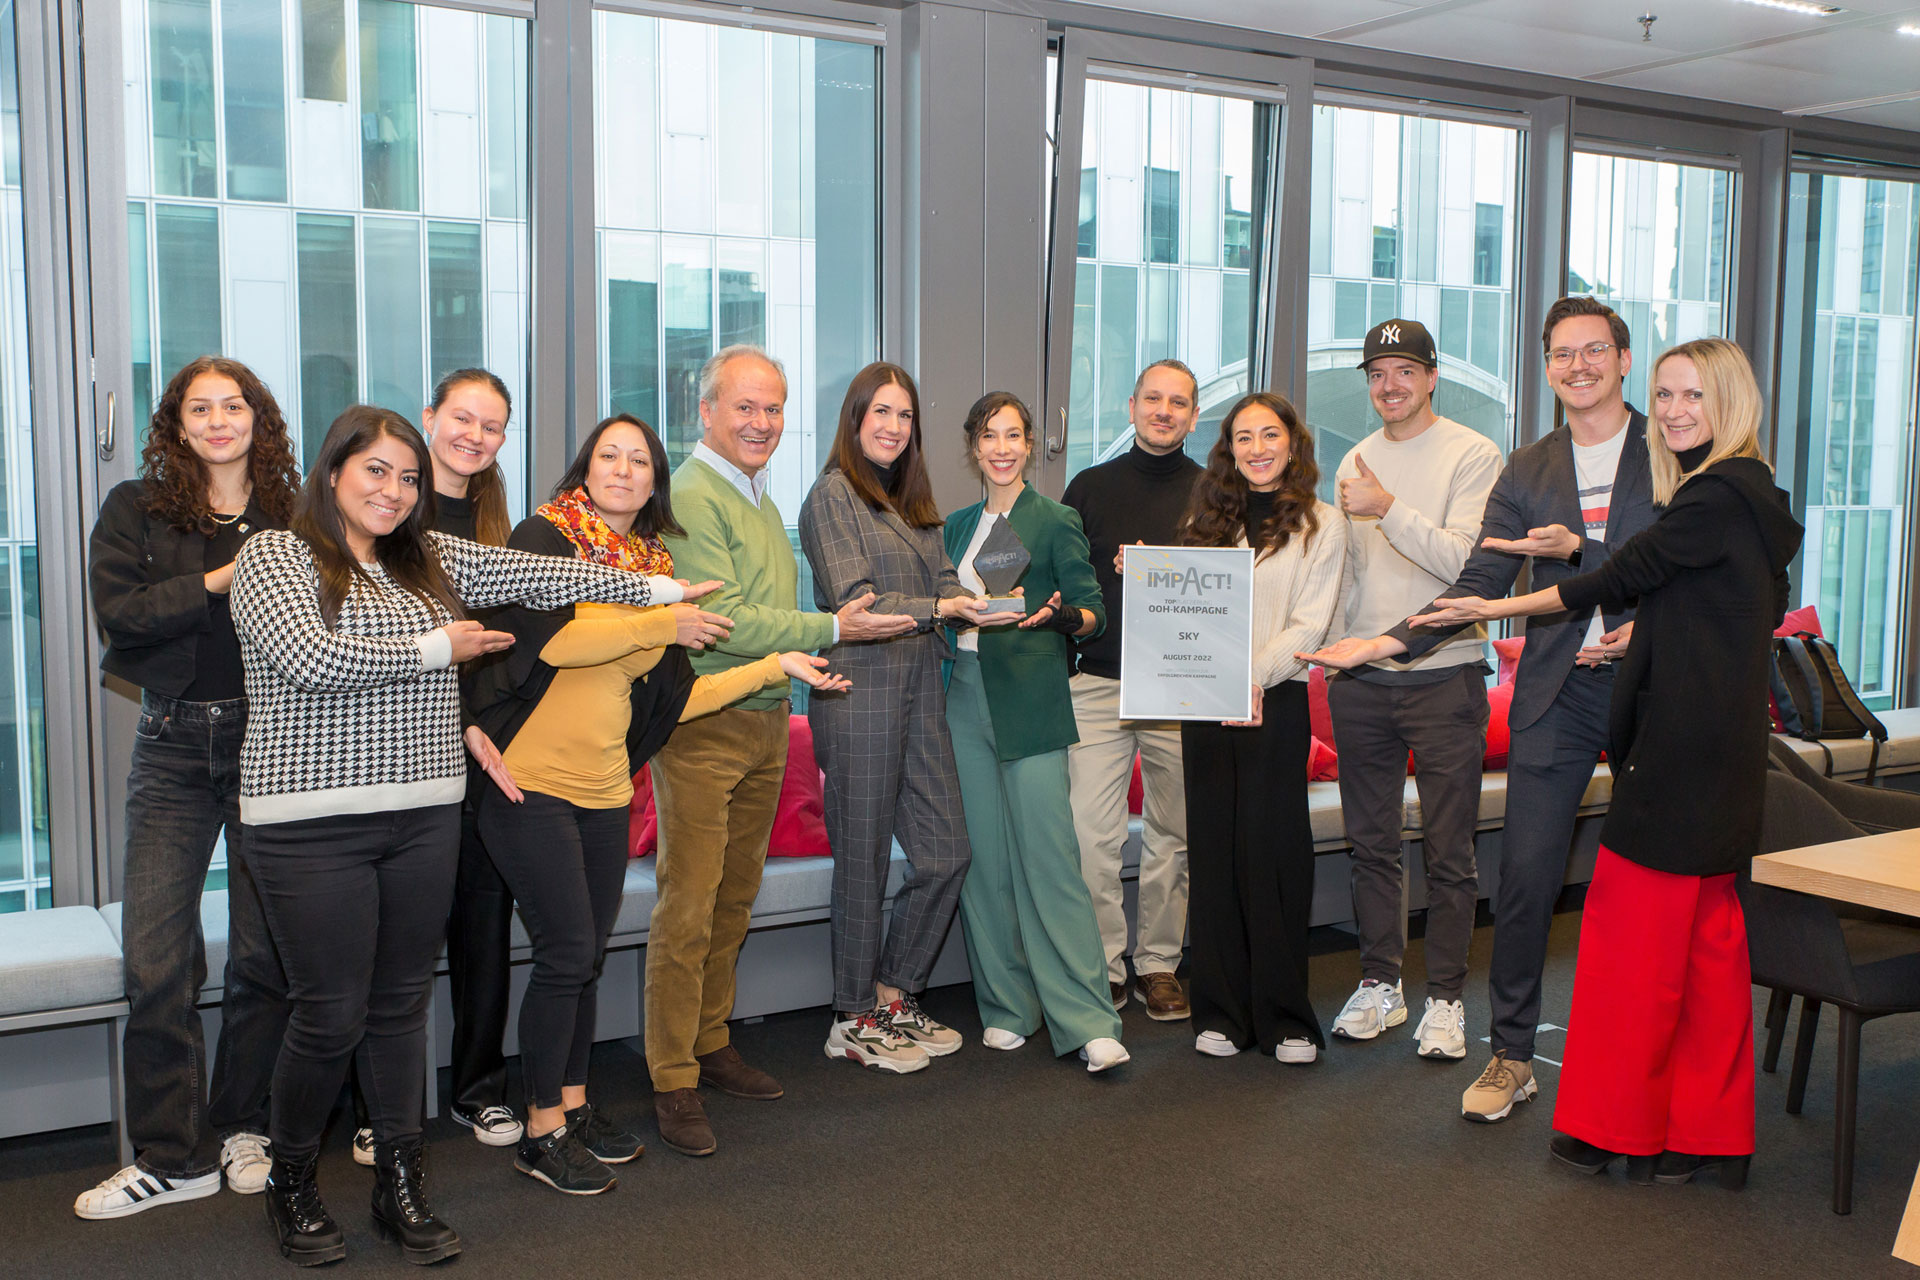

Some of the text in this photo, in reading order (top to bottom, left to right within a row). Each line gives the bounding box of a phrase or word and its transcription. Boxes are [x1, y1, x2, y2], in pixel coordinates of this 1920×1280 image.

[1147, 566, 1232, 596] IMPACT!
[1148, 604, 1229, 615] OOH-KAMPAGNE
[1178, 632, 1200, 641] SKY
